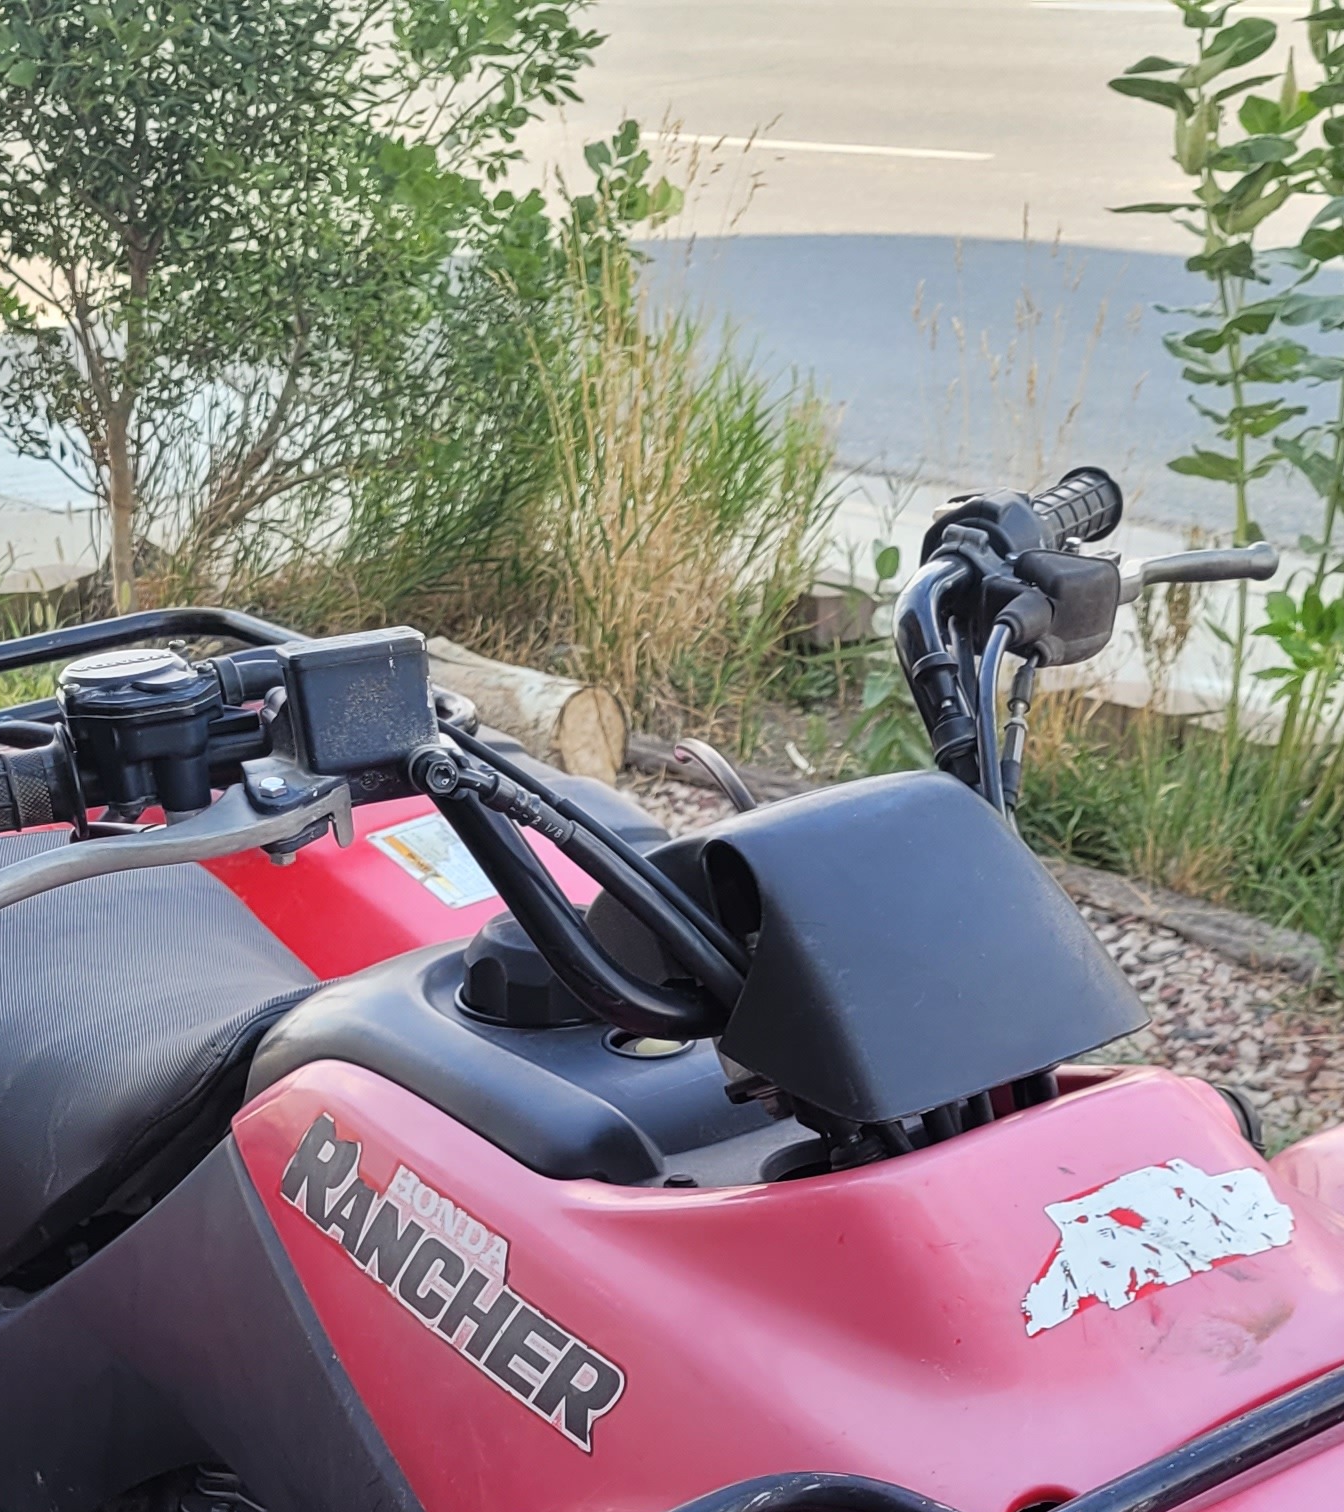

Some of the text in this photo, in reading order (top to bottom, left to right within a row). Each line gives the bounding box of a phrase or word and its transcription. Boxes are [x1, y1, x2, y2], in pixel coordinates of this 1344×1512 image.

[532, 815, 542, 825] 2
[388, 1165, 507, 1271] HONDA
[281, 1112, 625, 1452] RANCHER
